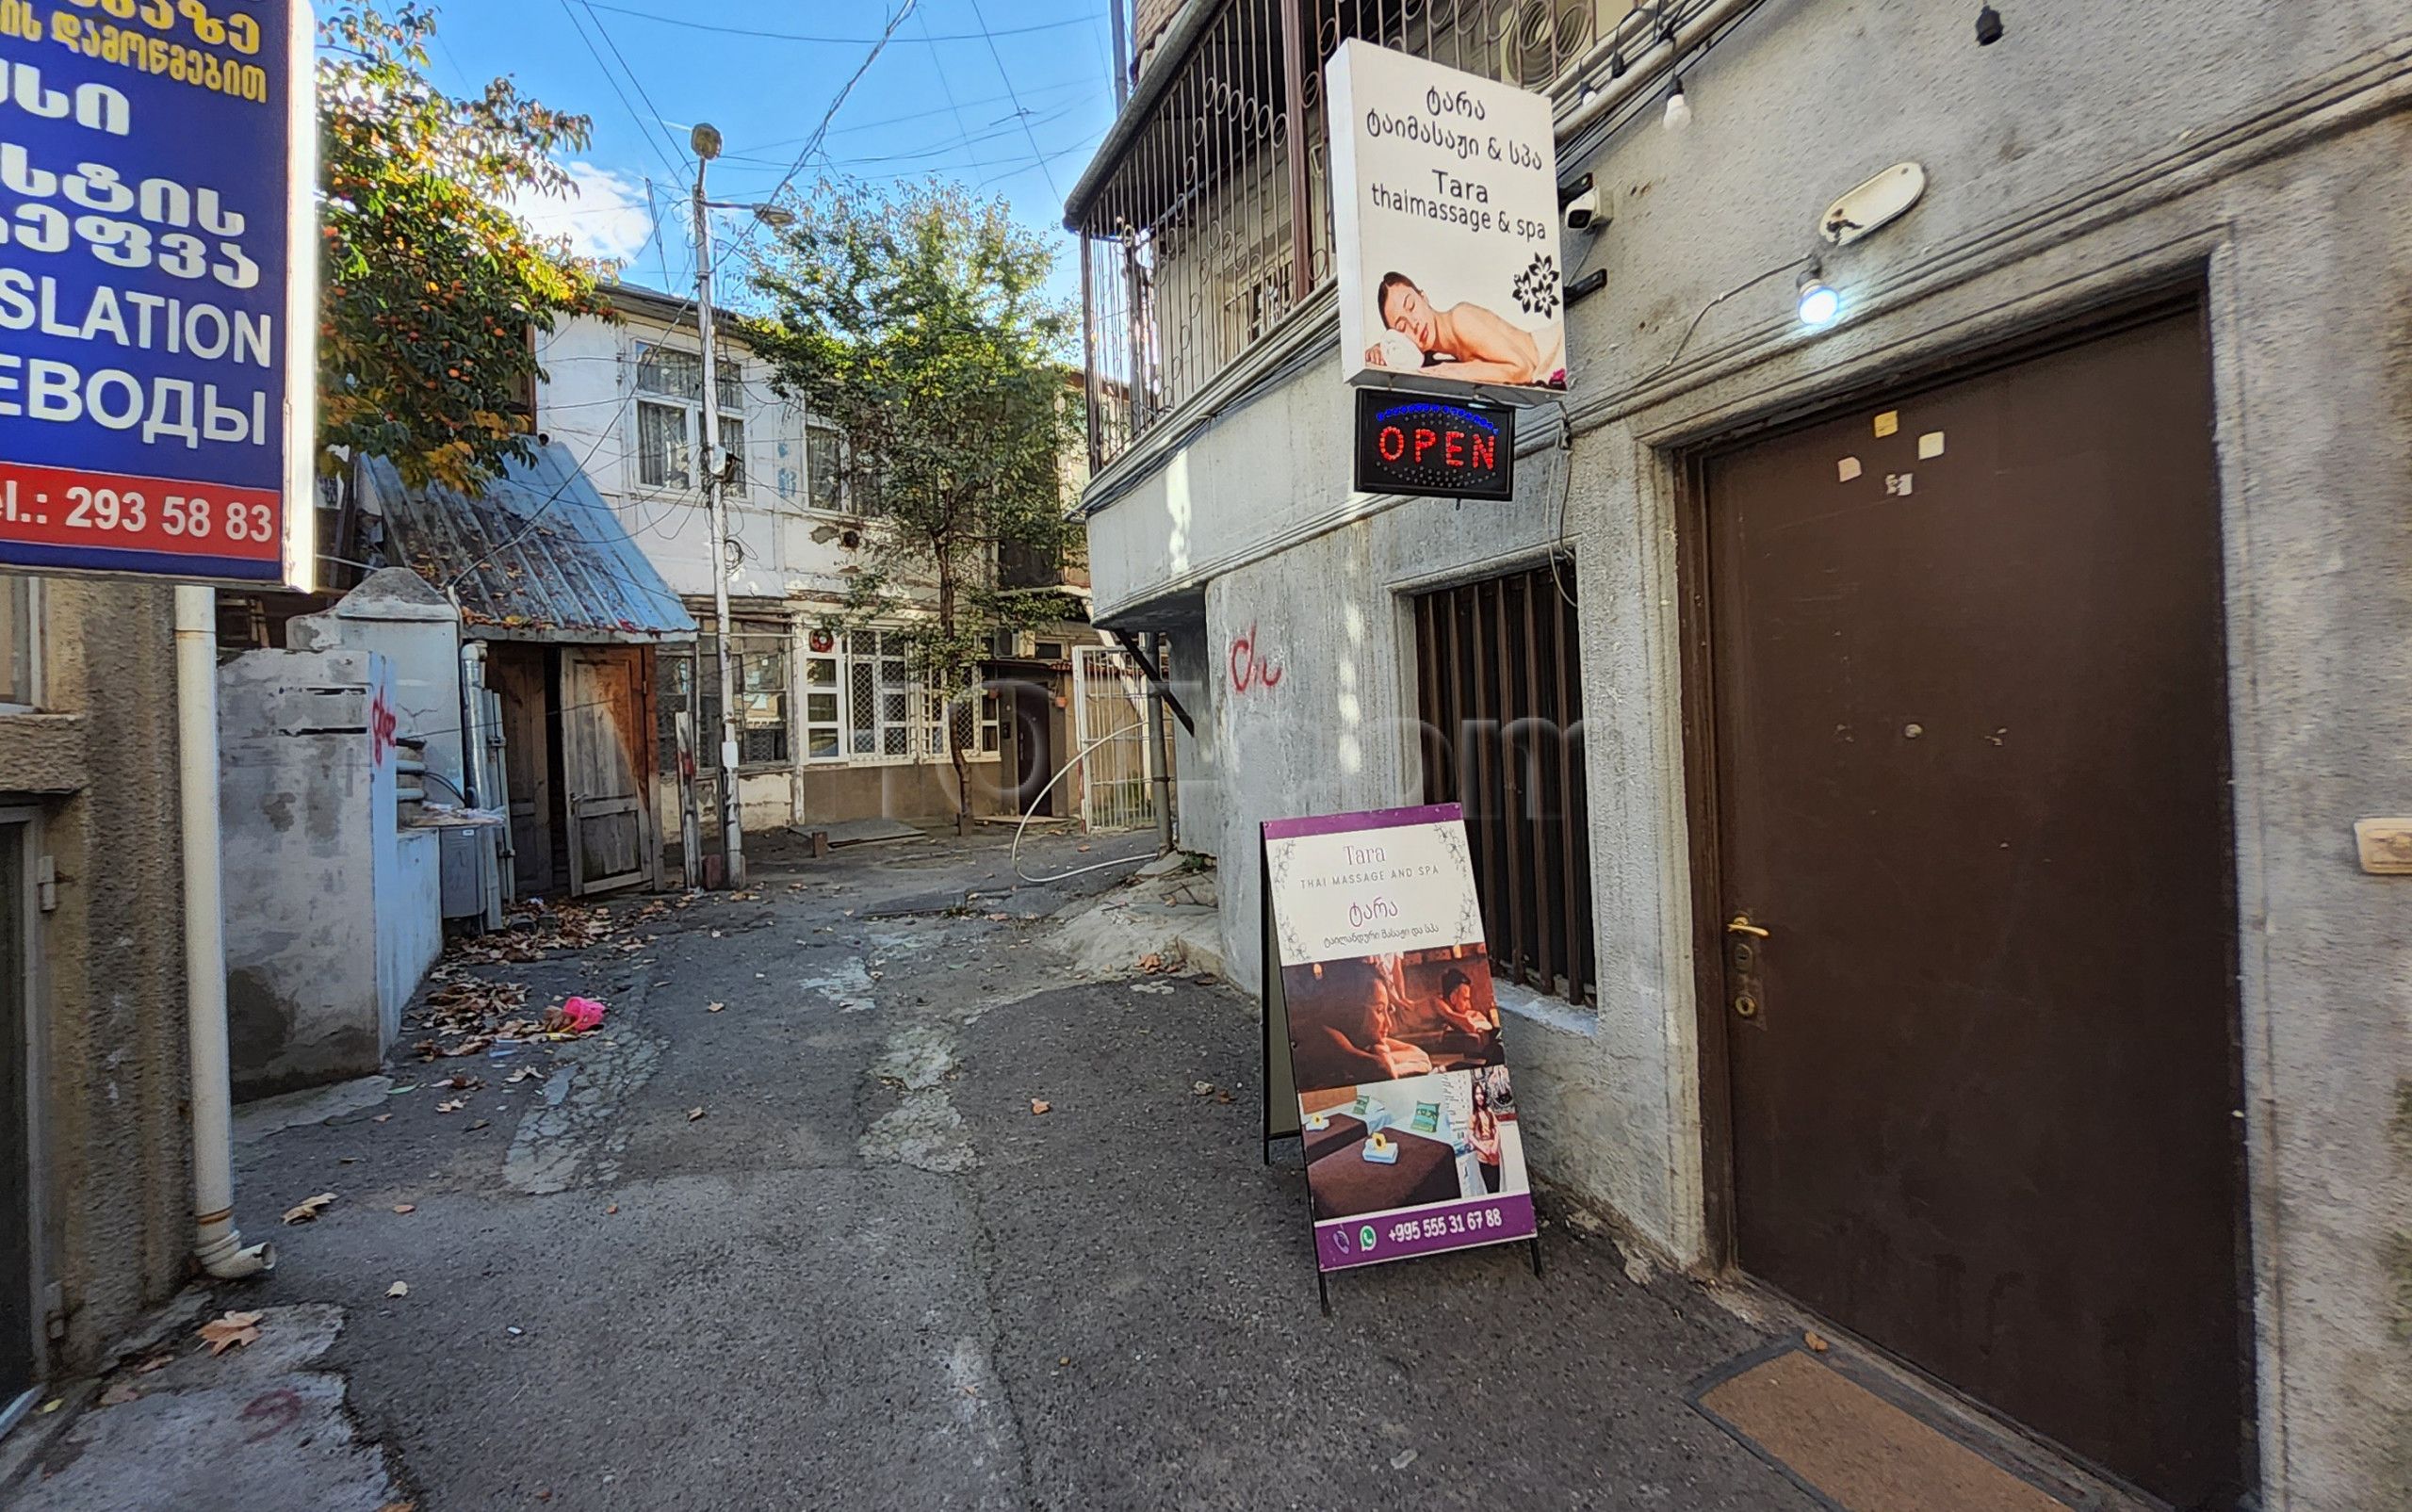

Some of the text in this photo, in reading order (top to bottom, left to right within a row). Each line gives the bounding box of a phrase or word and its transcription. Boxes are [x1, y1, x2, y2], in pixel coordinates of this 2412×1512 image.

[51, 10, 268, 104] დამოწმებით
[0, 57, 130, 137] სი
[1426, 85, 1486, 122] ტარა
[1366, 106, 1542, 171] ტაიმასაჟი & სპა
[1432, 169, 1489, 203] Tara
[1372, 183, 1546, 242] thaimassage & spa
[0, 203, 260, 289] ეფვა
[0, 268, 271, 368] SLATION
[1377, 425, 1496, 471] OPEN
[66, 486, 146, 532] 293
[161, 496, 211, 537] 58
[225, 502, 272, 543] 83
[1300, 865, 1440, 889] THAI MASSAGE AND SPA
[1344, 844, 1386, 866] Tara
[1348, 896, 1398, 928] ტარა
[1388, 1208, 1502, 1243] +995 555 31 67 88
